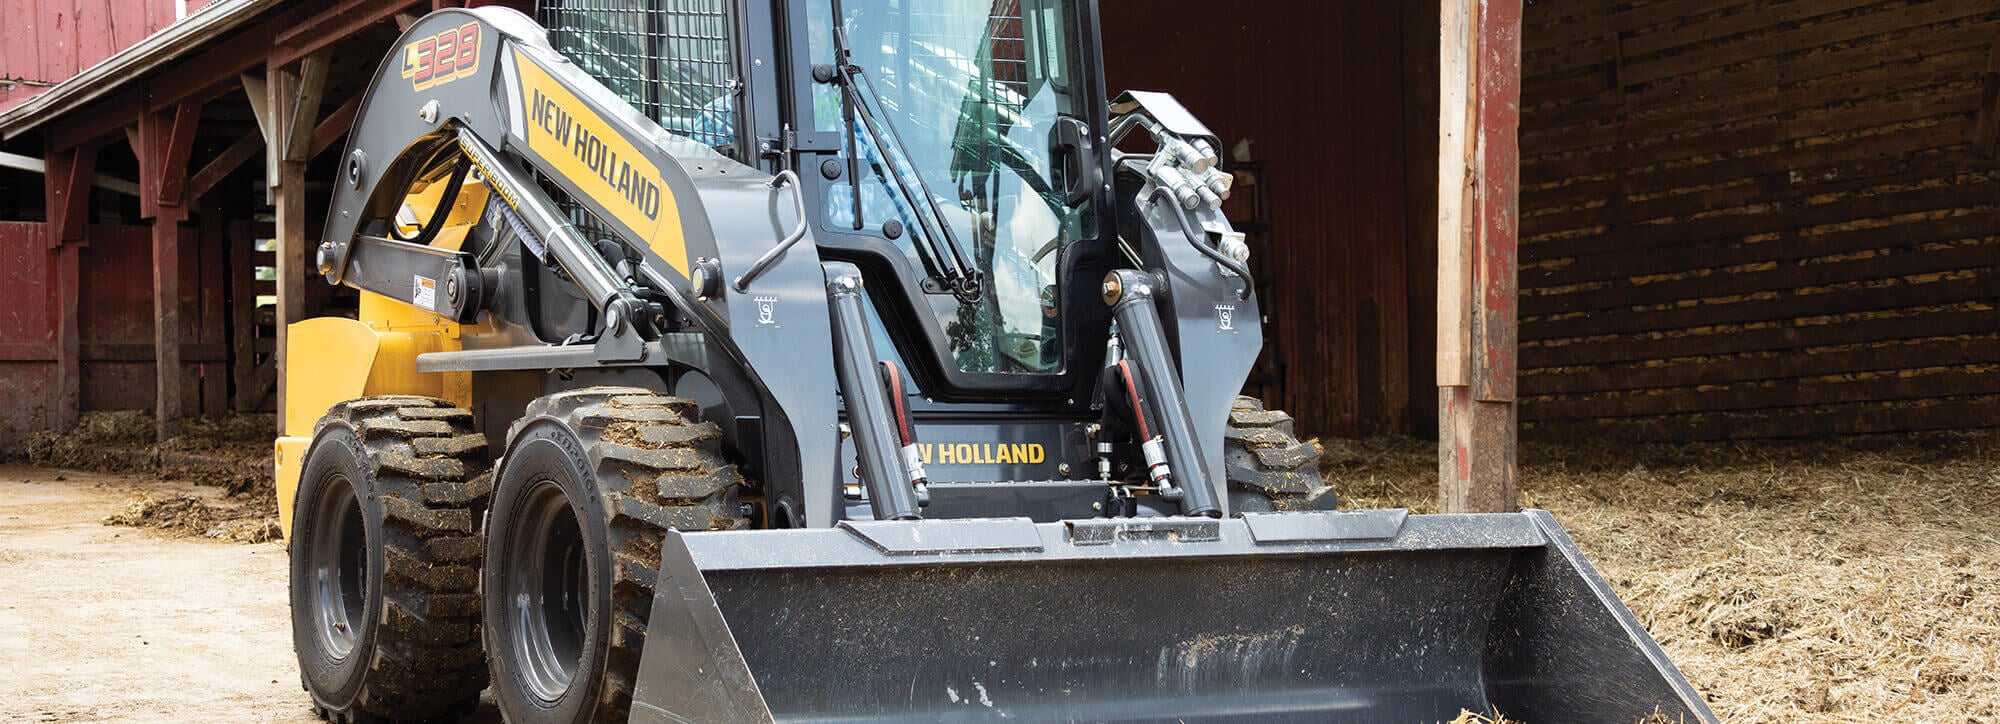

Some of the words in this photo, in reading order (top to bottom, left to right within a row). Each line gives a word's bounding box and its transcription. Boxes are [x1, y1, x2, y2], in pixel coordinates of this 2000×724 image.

[531, 87, 573, 148] NEW
[574, 122, 660, 222] HOLLAND
[938, 443, 1045, 464] HOLLAND
